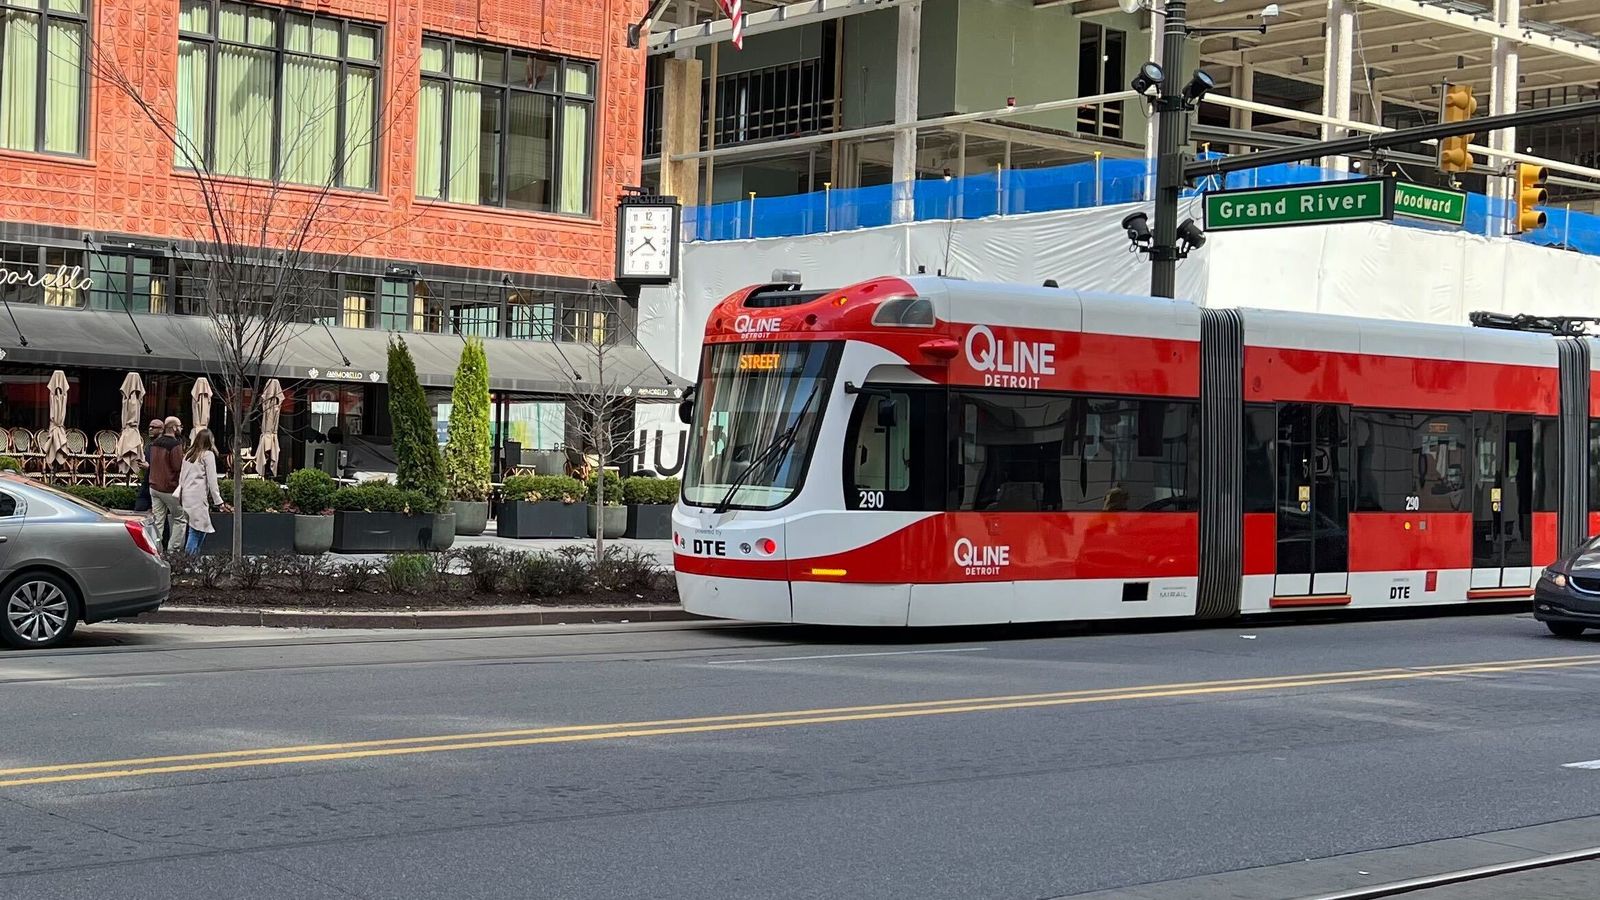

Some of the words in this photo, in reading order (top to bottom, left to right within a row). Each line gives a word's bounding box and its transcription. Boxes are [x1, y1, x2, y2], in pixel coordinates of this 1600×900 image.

[1220, 197, 1286, 219] Grand
[1300, 193, 1367, 213] River
[1394, 190, 1451, 214] Woodward
[645, 212, 653, 221] 12
[734, 315, 782, 333] QLINE
[965, 324, 1056, 375] QLINE
[740, 354, 781, 369] STREET
[984, 374, 1040, 389] DETROIT
[859, 491, 884, 509] 290
[1405, 496, 1420, 511] 290
[693, 538, 726, 556] DTE
[953, 537, 1010, 567] QLINE
[965, 567, 1000, 576] DETROIT
[1390, 586, 1411, 600] DTE
